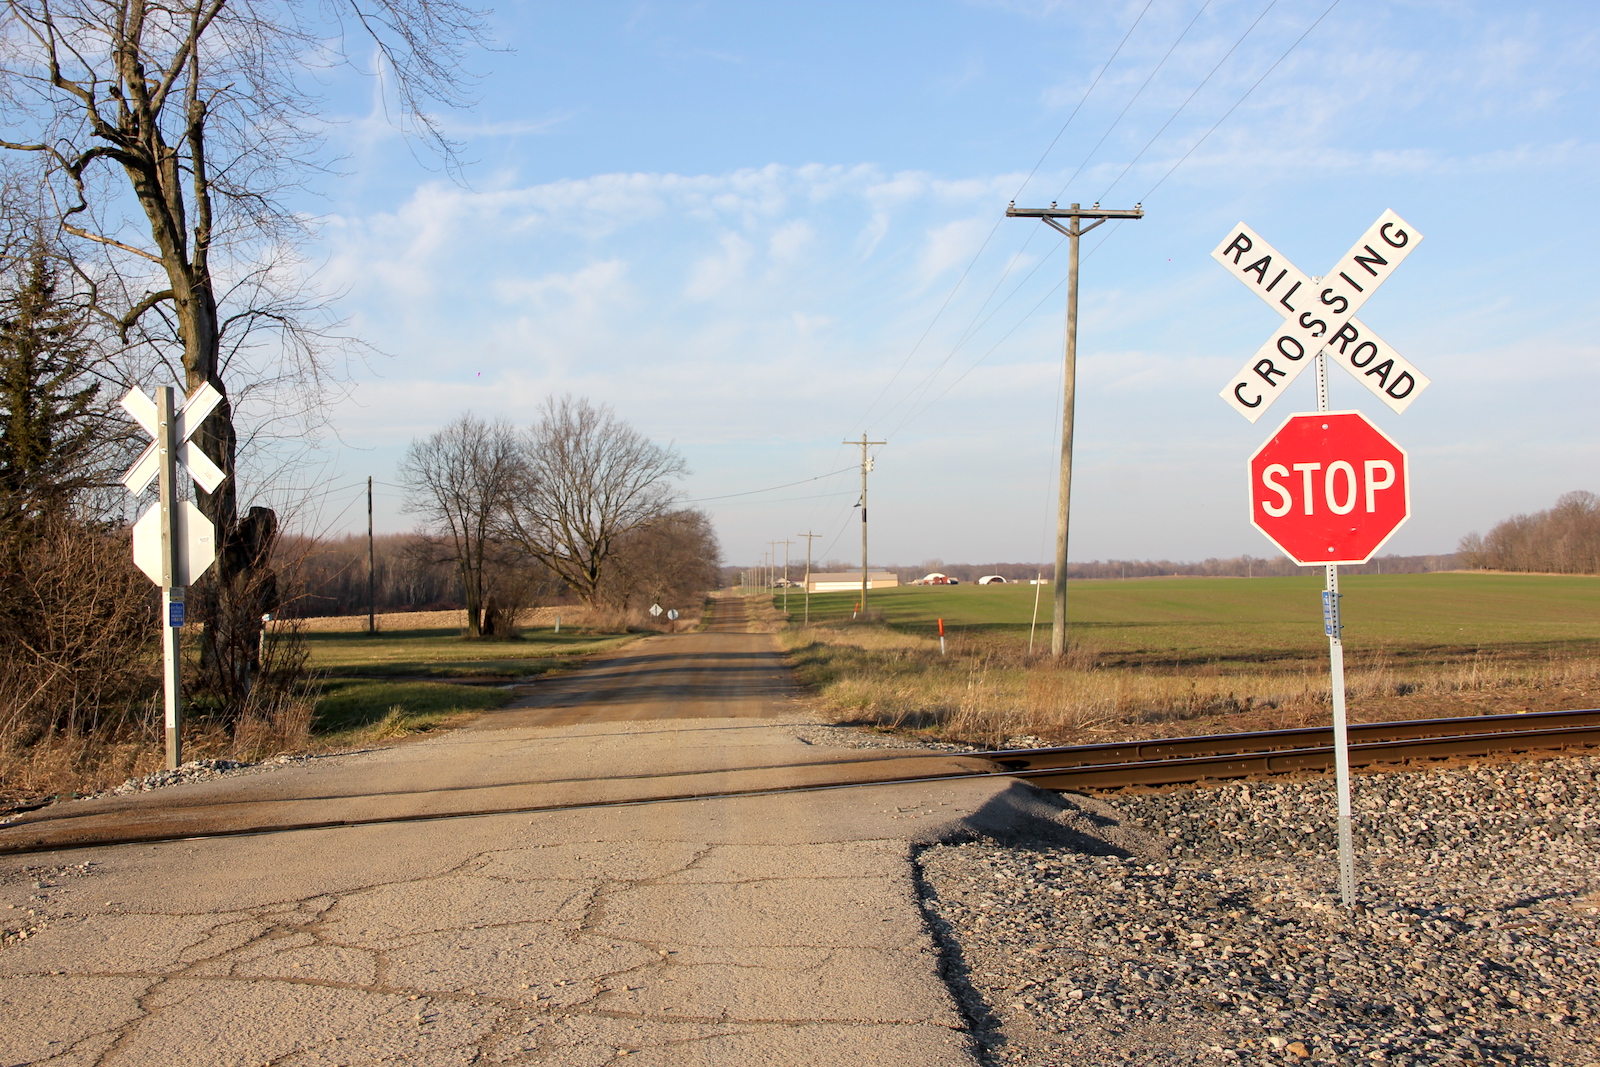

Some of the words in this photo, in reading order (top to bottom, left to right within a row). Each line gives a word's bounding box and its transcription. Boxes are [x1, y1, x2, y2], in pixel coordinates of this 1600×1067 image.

[1222, 232, 1302, 313] RAIL
[1327, 322, 1415, 400] ROAD
[1234, 222, 1409, 409] CROSSING
[1261, 459, 1396, 518] STOP
